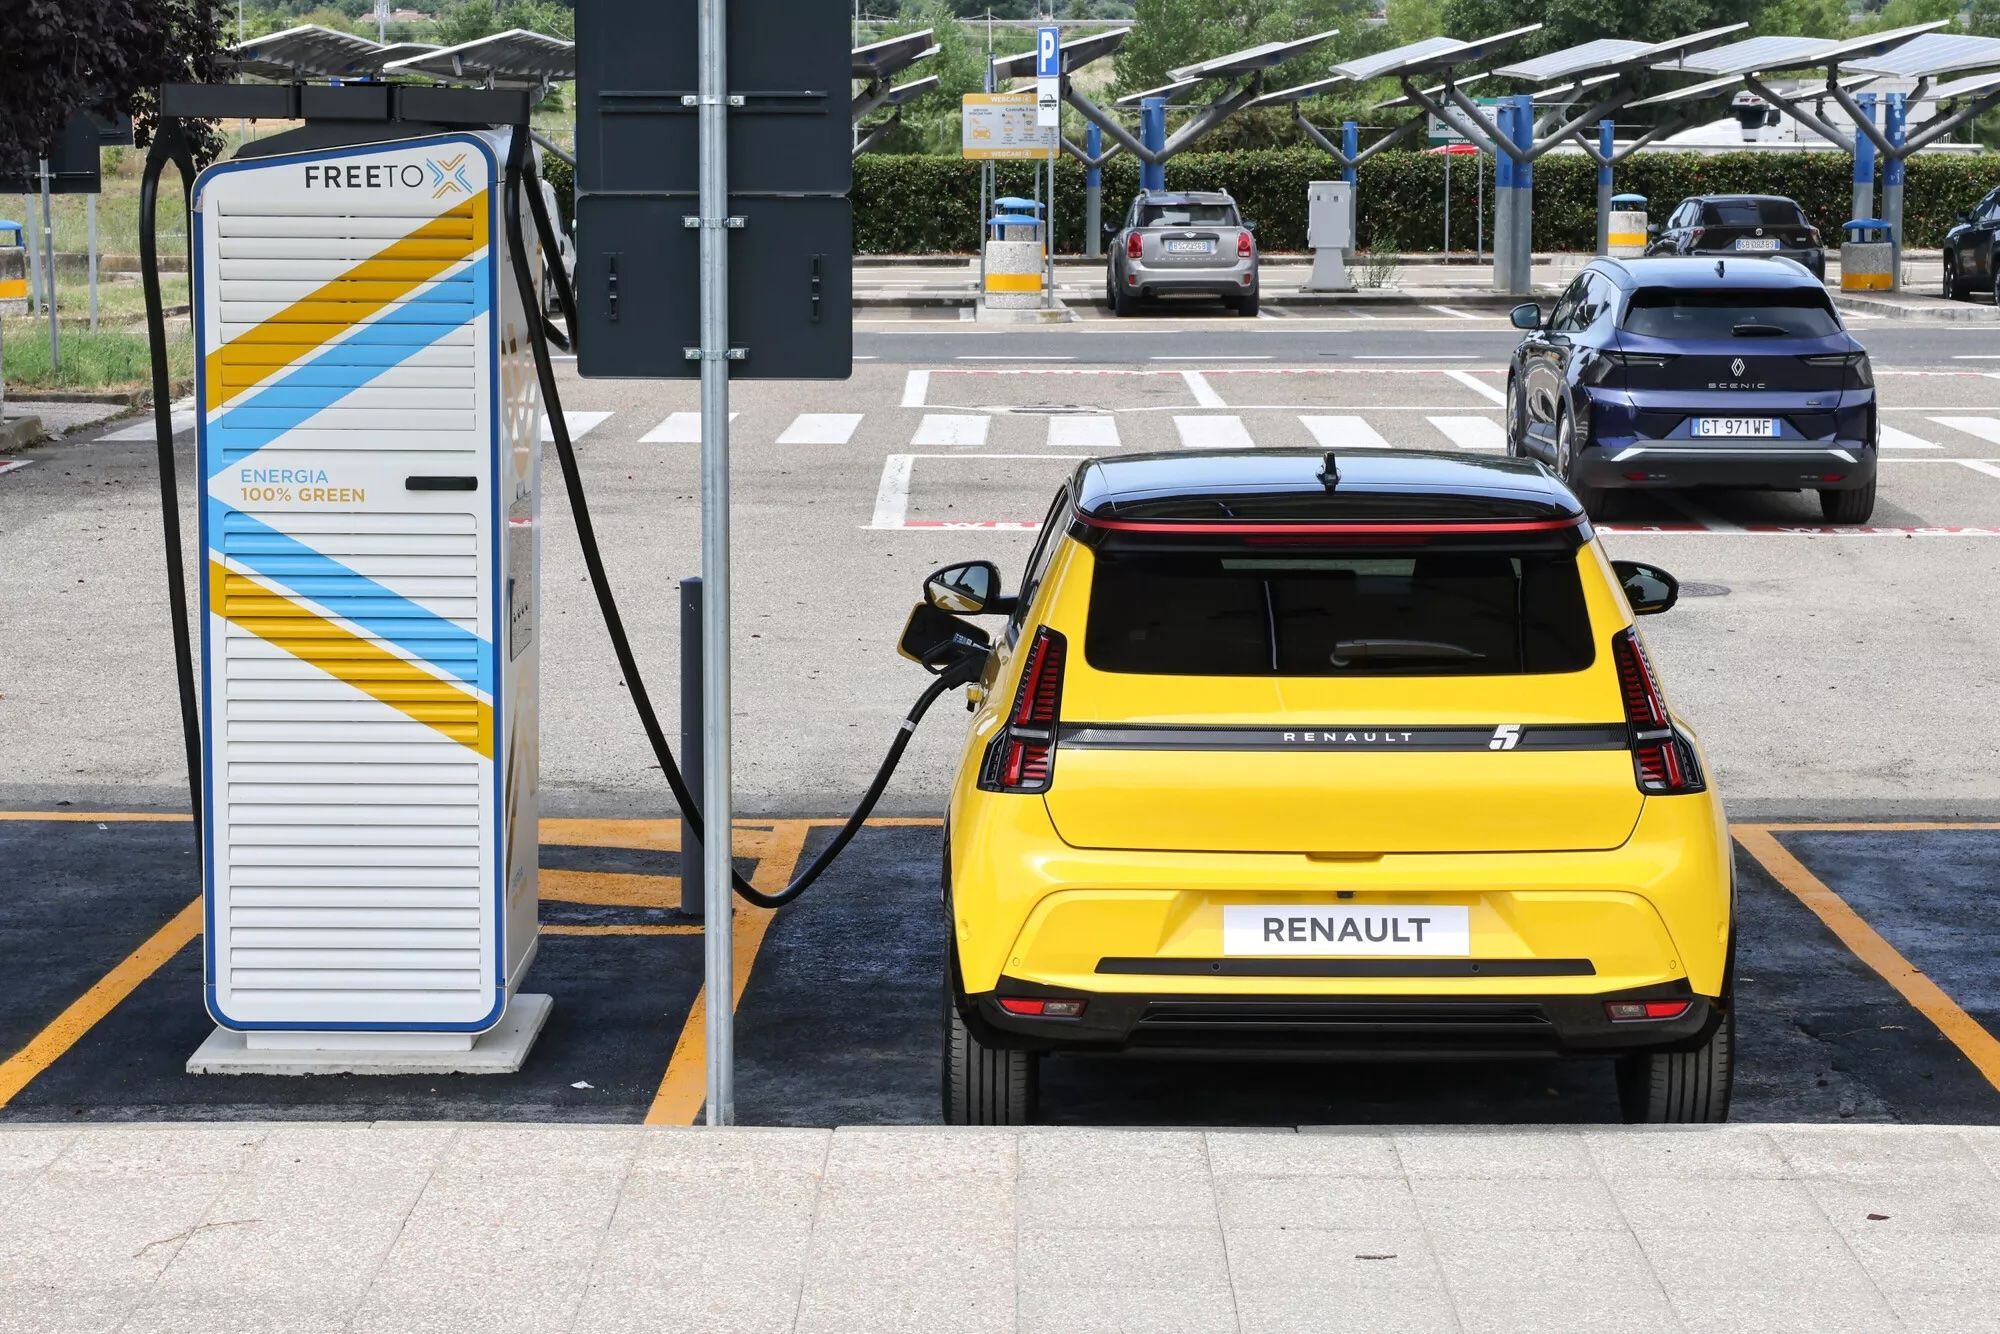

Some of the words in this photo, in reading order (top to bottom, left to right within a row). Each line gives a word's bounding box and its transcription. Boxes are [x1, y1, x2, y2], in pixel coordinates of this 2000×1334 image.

[1041, 31, 1055, 72] P
[1701, 419, 1719, 434] GT
[1725, 419, 1771, 435] 971WF
[241, 469, 329, 483] ENERGIA
[240, 487, 292, 502] 100%
[298, 487, 365, 502] GREEN
[1283, 732, 1413, 742] RENAULT
[1488, 724, 1521, 750] 5
[1263, 917, 1432, 942] RENAULT
